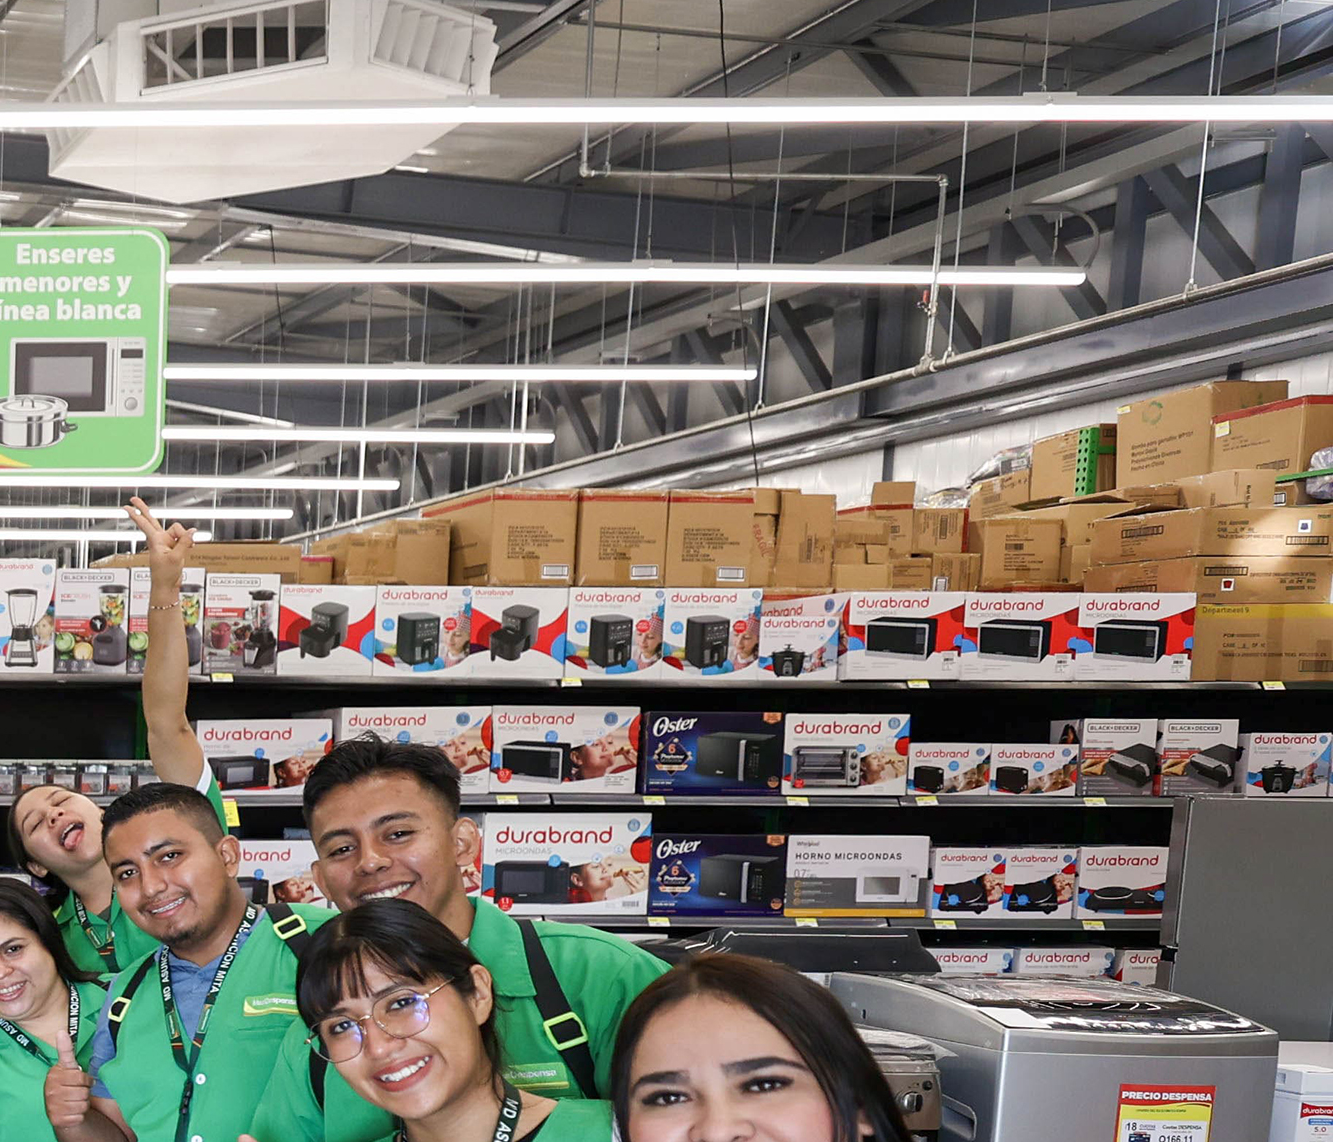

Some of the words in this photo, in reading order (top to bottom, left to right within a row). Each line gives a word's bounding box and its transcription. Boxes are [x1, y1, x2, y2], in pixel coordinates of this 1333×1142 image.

[16, 243, 115, 265] Enseres
[116, 275, 132, 297] y
[56, 299, 142, 321] blanca
[382, 589, 449, 601] durabrand
[575, 591, 642, 603] durabrand
[671, 592, 738, 604] durabrand
[857, 596, 930, 609] durabrand
[970, 599, 1044, 611] durabrand
[1086, 599, 1160, 611] durabrand
[764, 618, 826, 629] durabrand
[349, 713, 427, 727] durabrand
[498, 712, 575, 726] durabrand
[652, 716, 699, 737] Oster
[793, 721, 882, 735] durabrand
[204, 727, 292, 741] durabrand
[1254, 734, 1317, 745] durabrand
[668, 743, 677, 754] 6
[915, 749, 970, 759] durabrand
[997, 750, 1055, 759] durabrand
[495, 826, 613, 844] durabrand
[495, 847, 552, 855] MICROONDAS
[656, 838, 701, 859] Oster
[240, 848, 291, 862] brand
[795, 852, 832, 860] HORNO
[835, 852, 902, 860] MICROONDAS
[941, 854, 988, 862] durabrand
[1011, 854, 1058, 863] durabrand
[1087, 854, 1159, 867] durabrand
[671, 866, 679, 876] 6
[1025, 951, 1091, 963] durabrand
[1129, 953, 1161, 964] dura
[211, 965, 231, 995] MITA
[164, 986, 173, 1002] MD
[69, 1014, 79, 1037] MITA
[16, 1032, 30, 1047] MD
[1122, 1090, 1161, 1100] PRECIO
[1161, 1092, 1212, 1101] DESPENSA
[1126, 1122, 1137, 1131] 18
